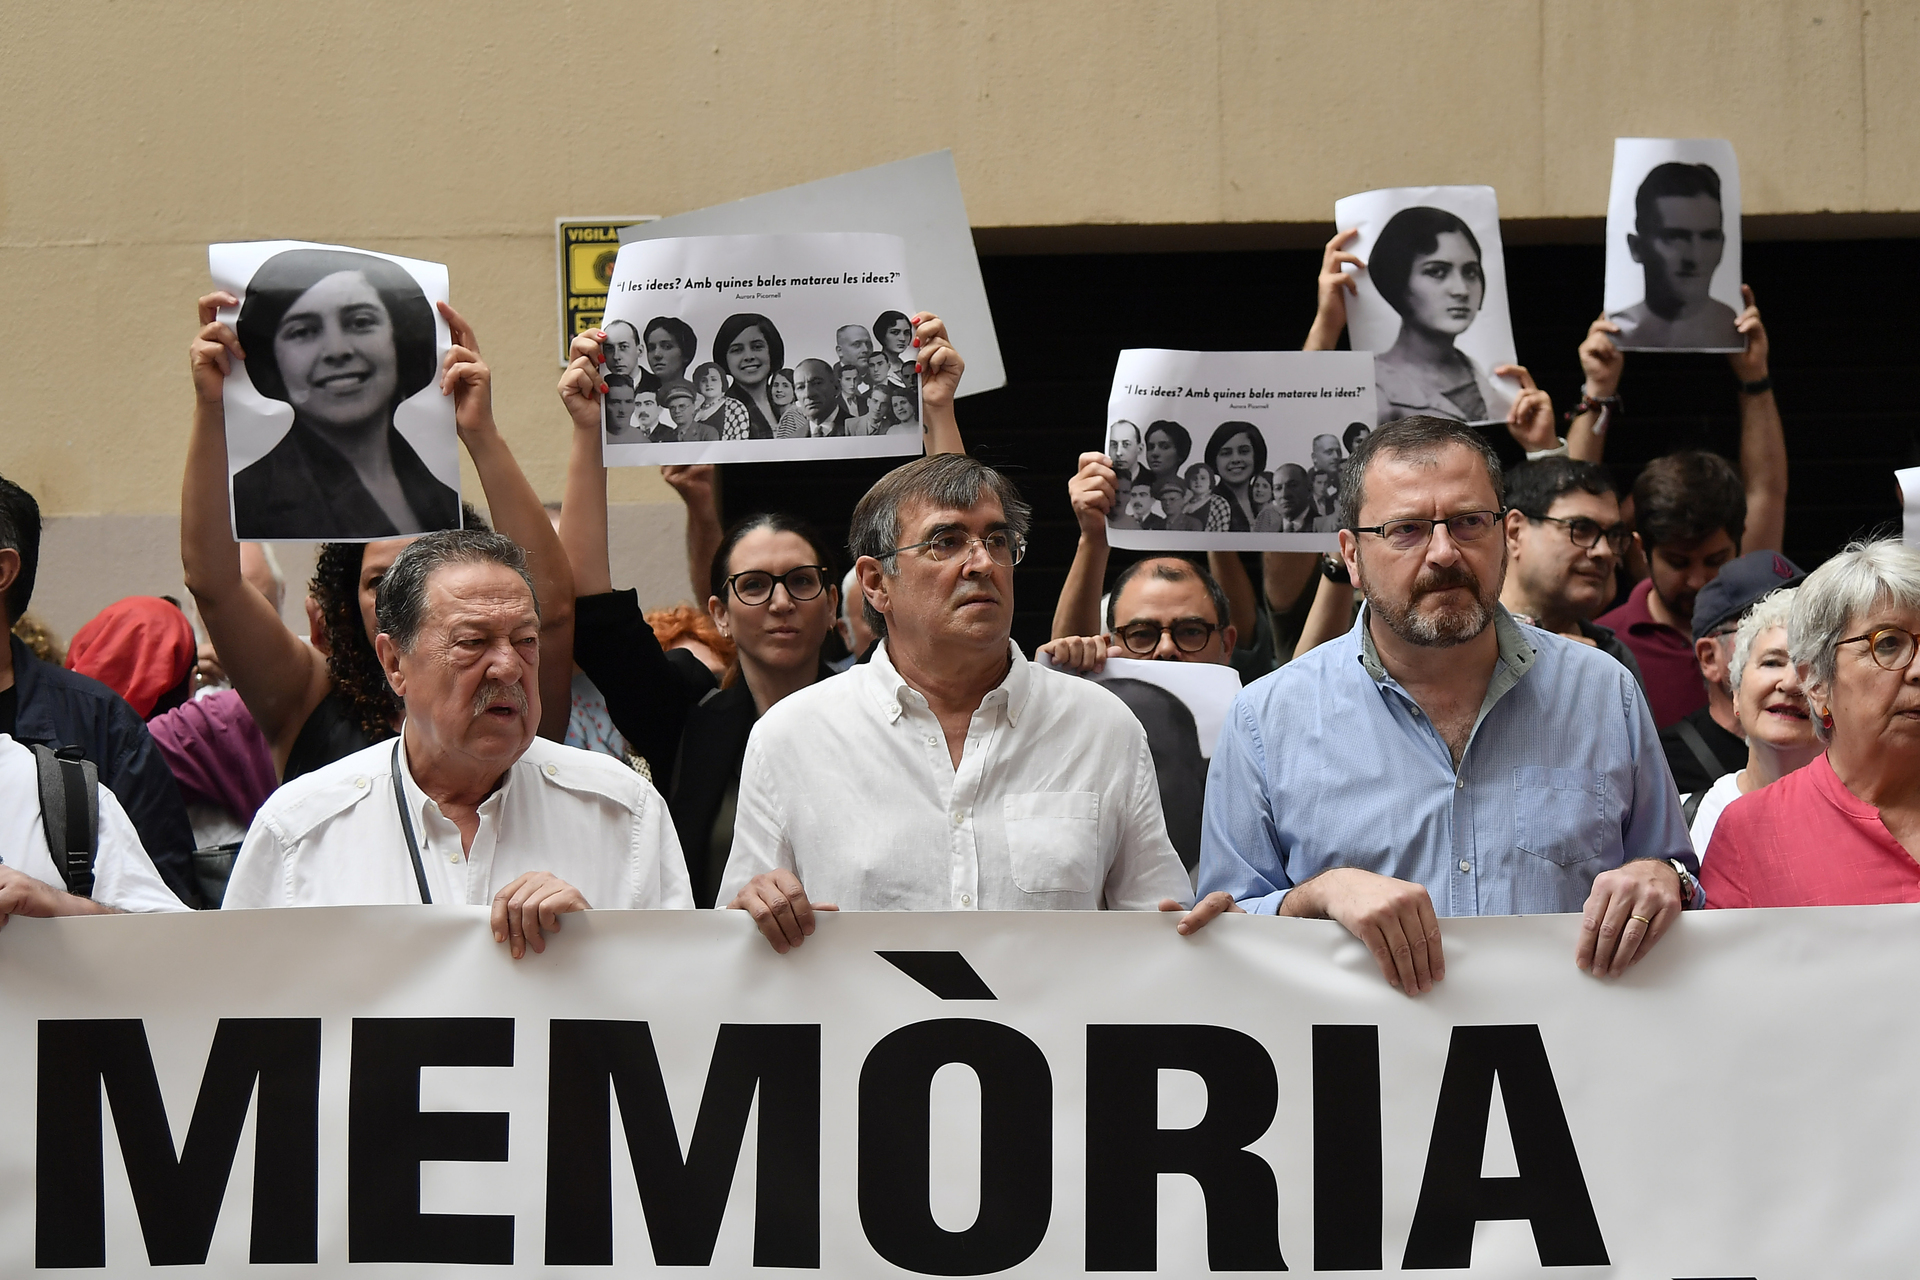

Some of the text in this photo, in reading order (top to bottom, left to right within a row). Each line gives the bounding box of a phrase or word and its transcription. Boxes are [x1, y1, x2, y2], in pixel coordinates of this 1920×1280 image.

[628, 281, 642, 291] les
[646, 278, 681, 290] idees?
[684, 277, 712, 289] Amb
[715, 276, 753, 292] quines
[757, 275, 787, 287] bales
[790, 275, 839, 286] matareu
[843, 272, 858, 284] les
[1134, 384, 1147, 395] les
[1150, 386, 1183, 398] idees?
[1185, 387, 1210, 398] Amb
[1213, 388, 1246, 403] quines
[1249, 387, 1274, 399] bales
[1277, 389, 1318, 399] matareu
[1320, 387, 1332, 398] les
[36, 951, 1611, 1276] MEMÒRIA
